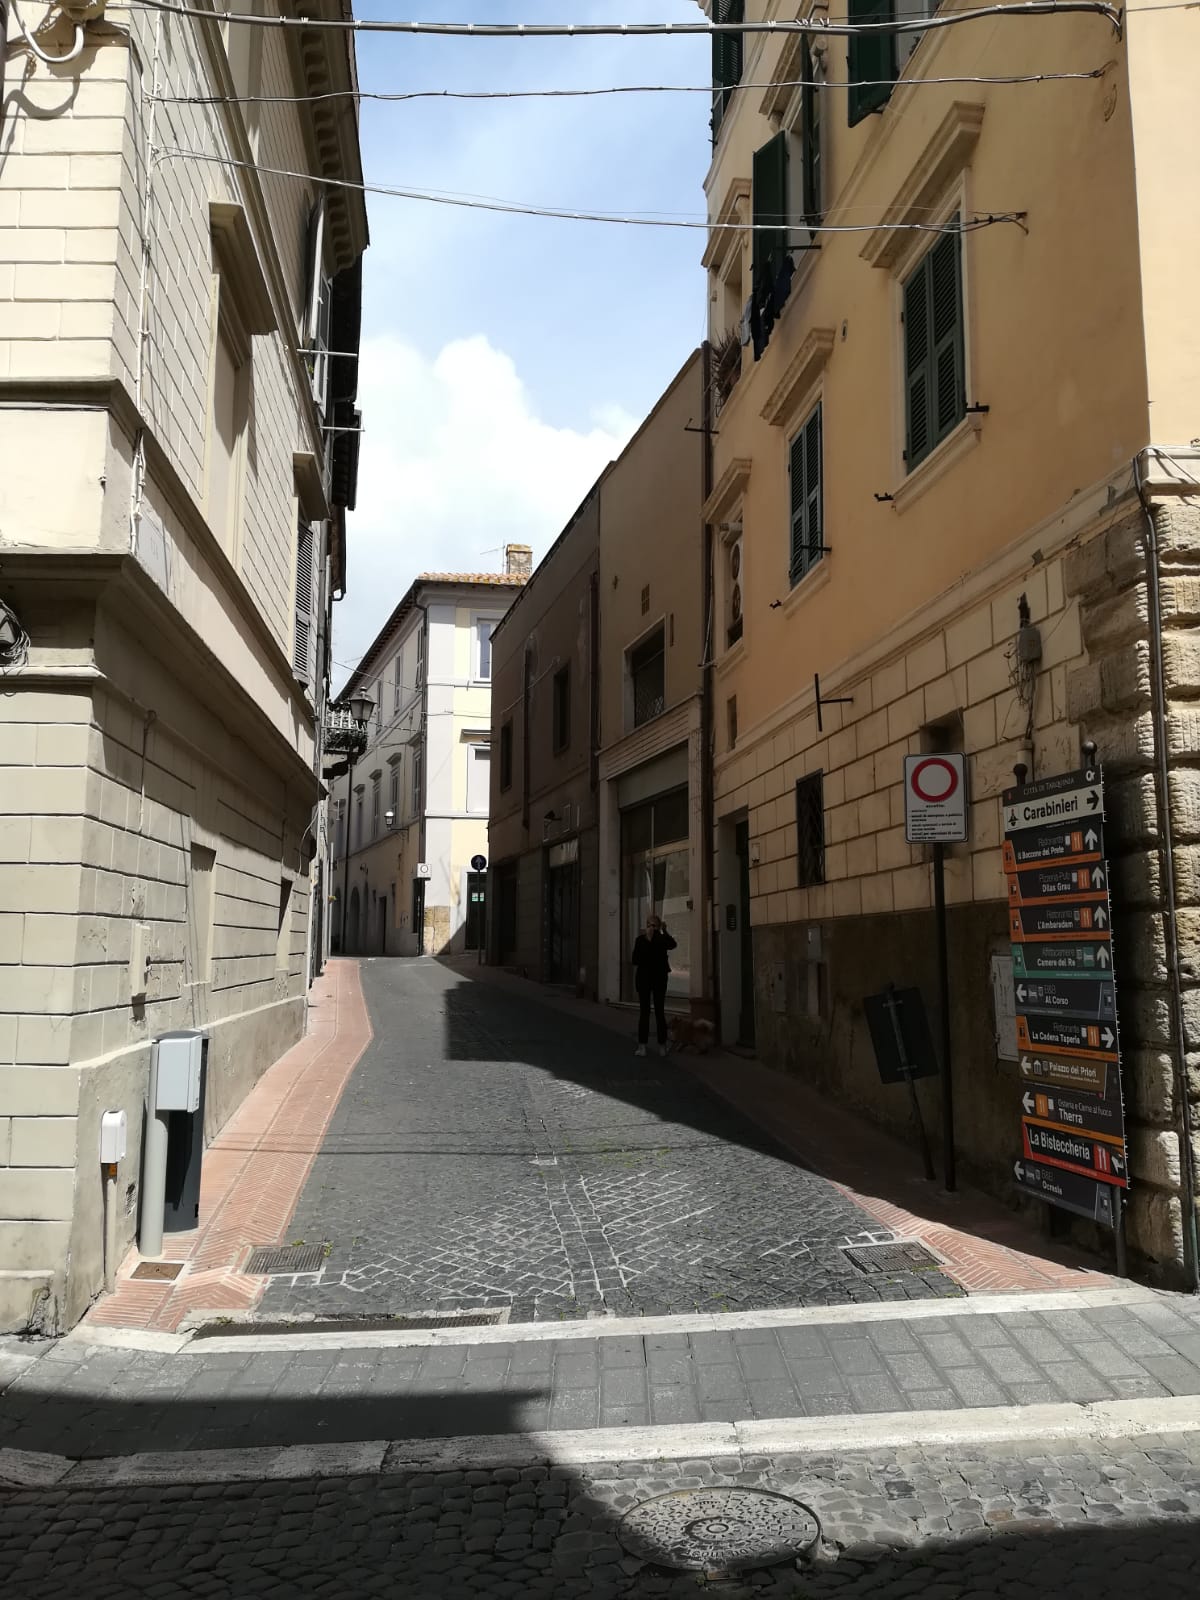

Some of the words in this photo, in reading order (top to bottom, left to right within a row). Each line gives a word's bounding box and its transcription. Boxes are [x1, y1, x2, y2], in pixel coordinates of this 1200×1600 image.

[1023, 797, 1078, 820] Carabinieri
[1052, 995, 1069, 1006] Corso
[1032, 1031, 1039, 1040] La
[1049, 1061, 1070, 1074] Palazzo
[1080, 1066, 1097, 1078] Priori
[1058, 1108, 1084, 1124] Therra
[1029, 1128, 1039, 1145] La
[1040, 1131, 1091, 1160] Bisteccheria
